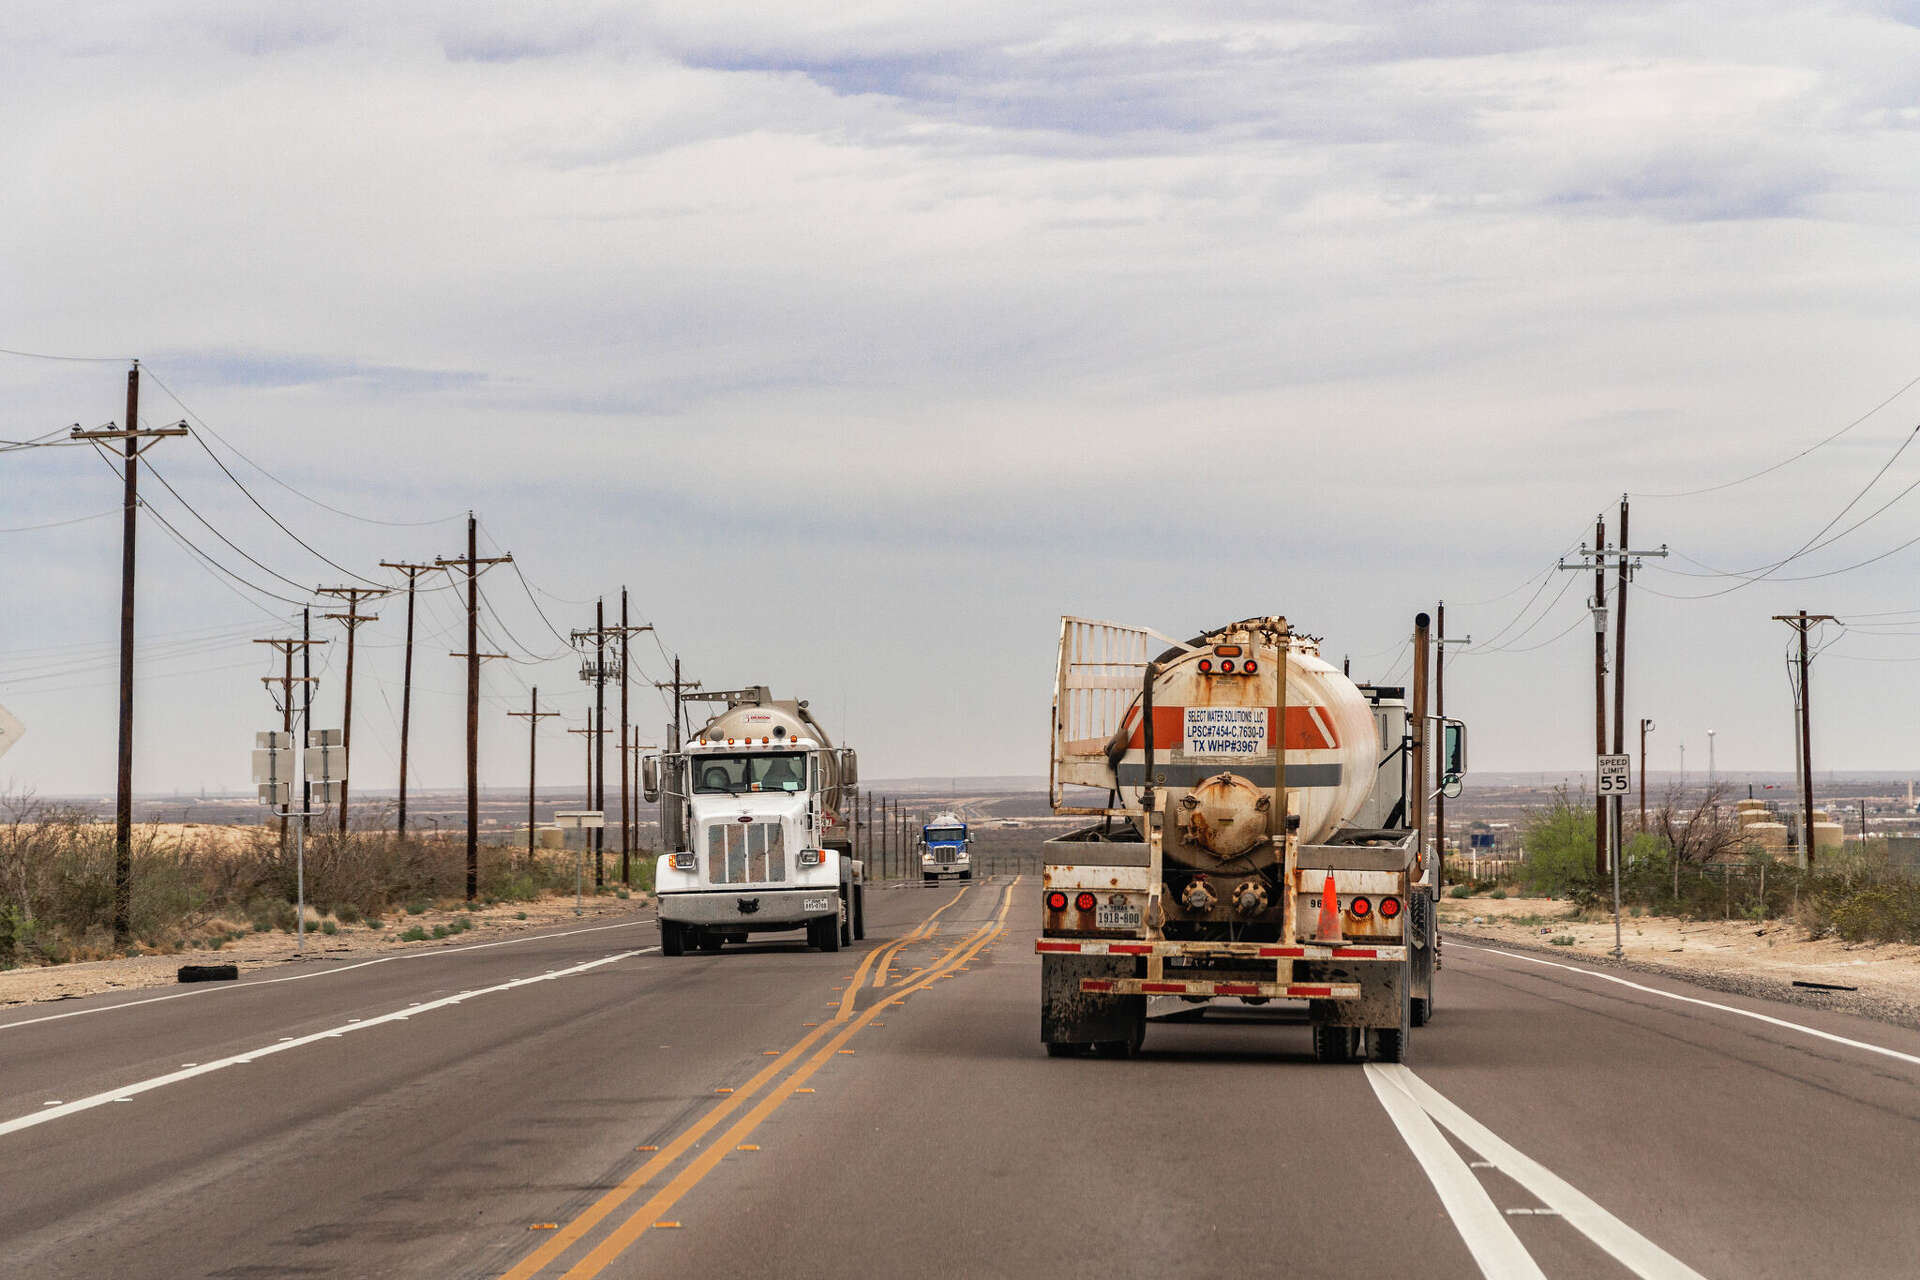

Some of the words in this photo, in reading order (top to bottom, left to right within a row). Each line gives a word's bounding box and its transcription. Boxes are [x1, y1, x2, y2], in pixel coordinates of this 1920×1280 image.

[1188, 711, 1206, 722] SELECT
[1207, 711, 1224, 722] WATER
[1254, 711, 1264, 723] LLC
[1193, 740, 1205, 752] TX
[1208, 740, 1258, 752] WHP#3967
[1601, 776, 1627, 790] 55
